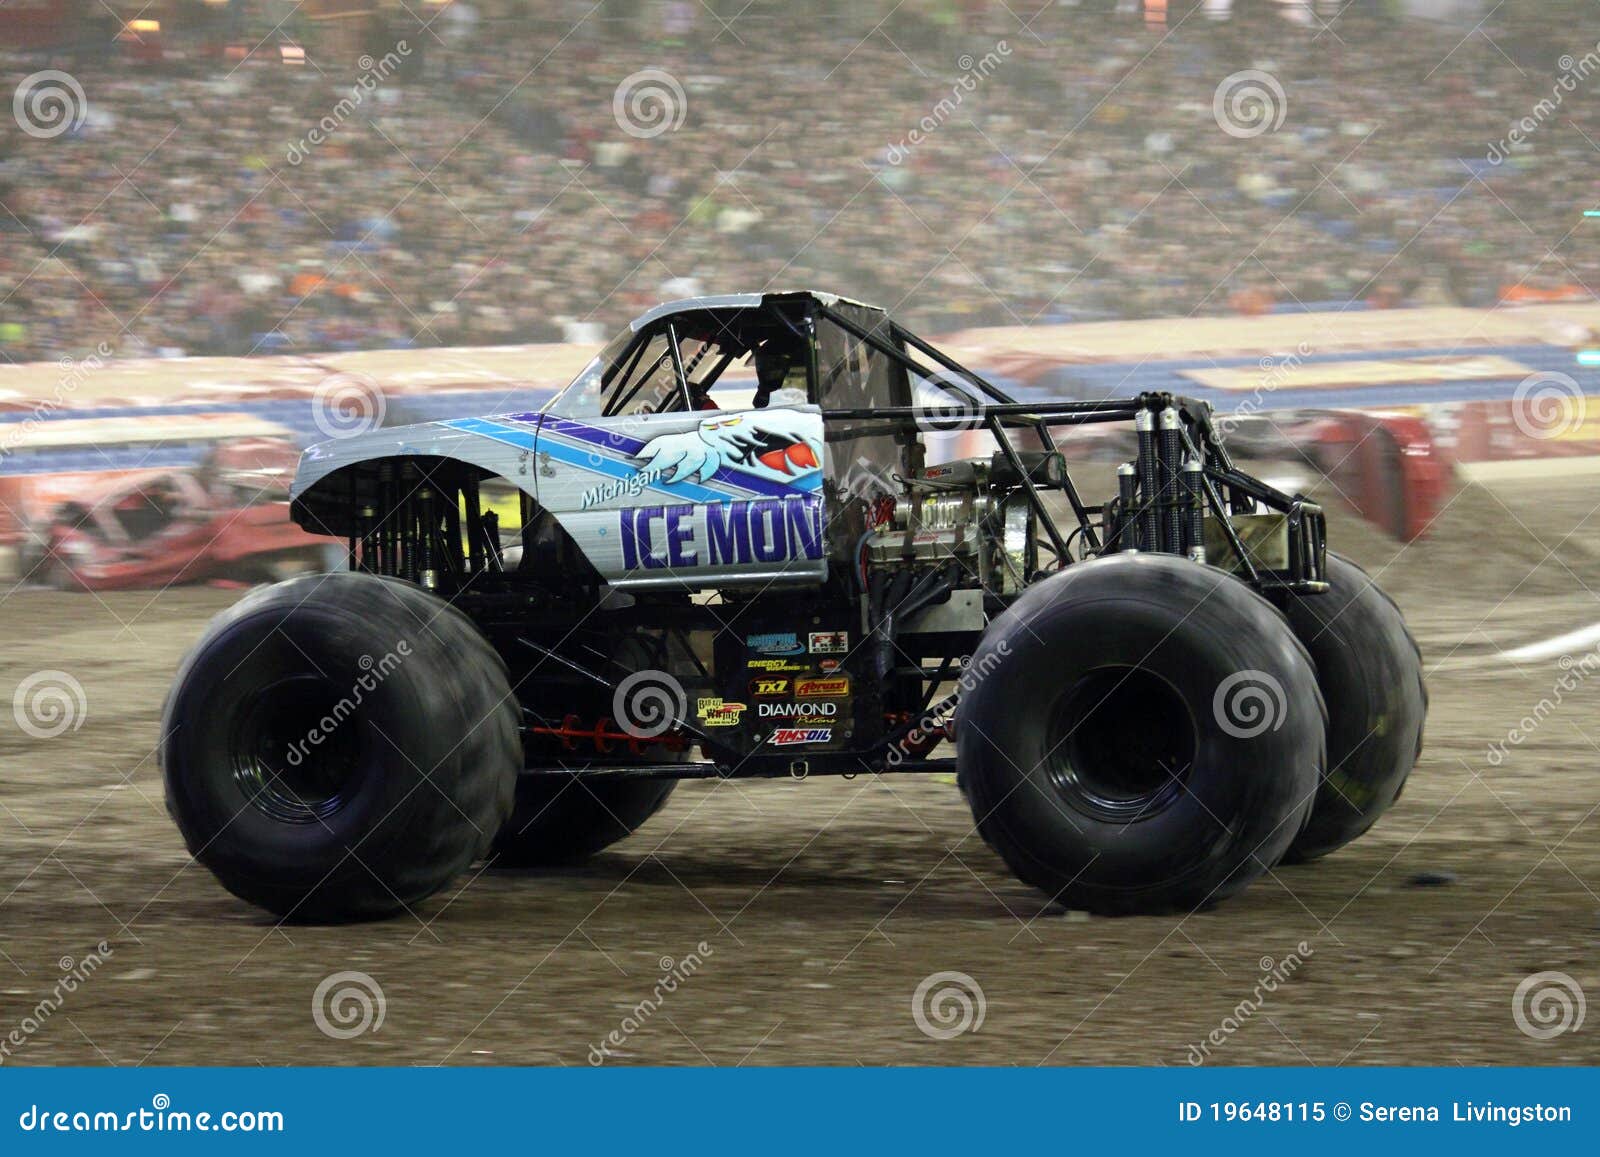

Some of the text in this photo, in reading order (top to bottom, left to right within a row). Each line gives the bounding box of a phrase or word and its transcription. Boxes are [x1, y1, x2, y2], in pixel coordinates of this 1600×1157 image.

[580, 468, 662, 509] Michigan
[619, 494, 823, 570] ICE MON
[757, 680, 788, 693] TX7
[758, 703, 837, 717] DIAMOND
[771, 728, 831, 745] AMSOIL
